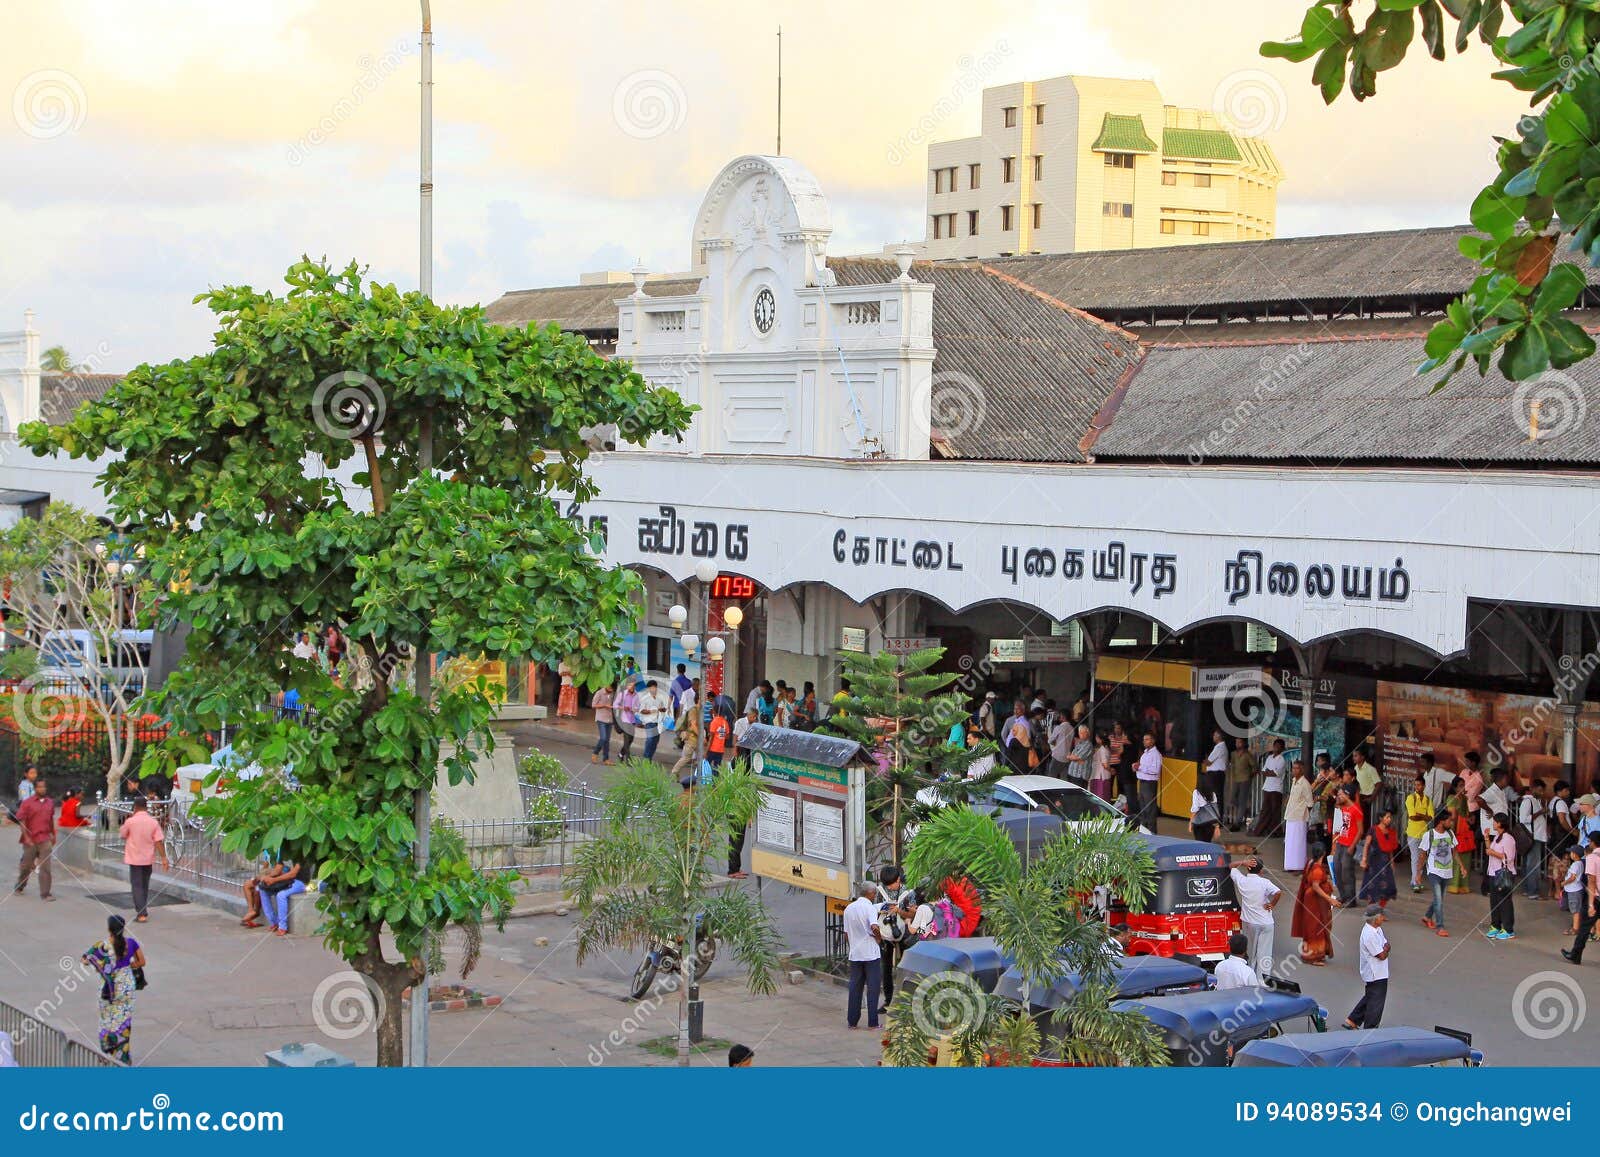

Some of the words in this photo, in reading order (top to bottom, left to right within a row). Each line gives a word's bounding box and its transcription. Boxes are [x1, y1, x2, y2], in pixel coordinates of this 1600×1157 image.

[832, 528, 963, 571] கோட்டை
[1001, 540, 1178, 600] புகையிரத
[1224, 549, 1411, 606] நிலையம்
[1205, 672, 1231, 681] RAILWAY
